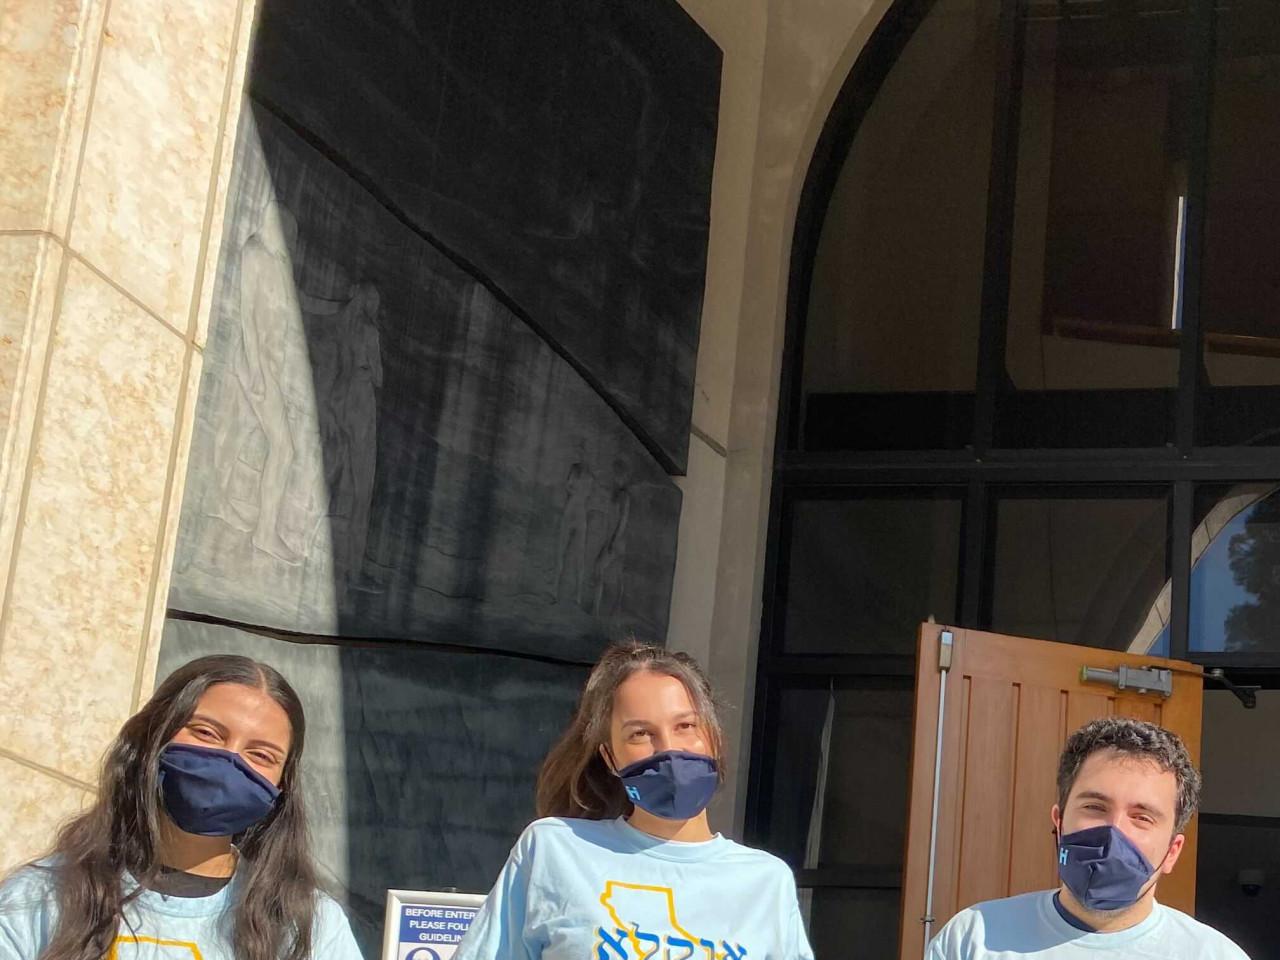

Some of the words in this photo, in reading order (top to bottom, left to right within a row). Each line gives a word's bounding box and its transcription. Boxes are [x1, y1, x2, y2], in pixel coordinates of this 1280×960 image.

[405, 908, 444, 918] BEFORE
[445, 910, 476, 920] ENTER
[409, 920, 446, 930] PLEASE
